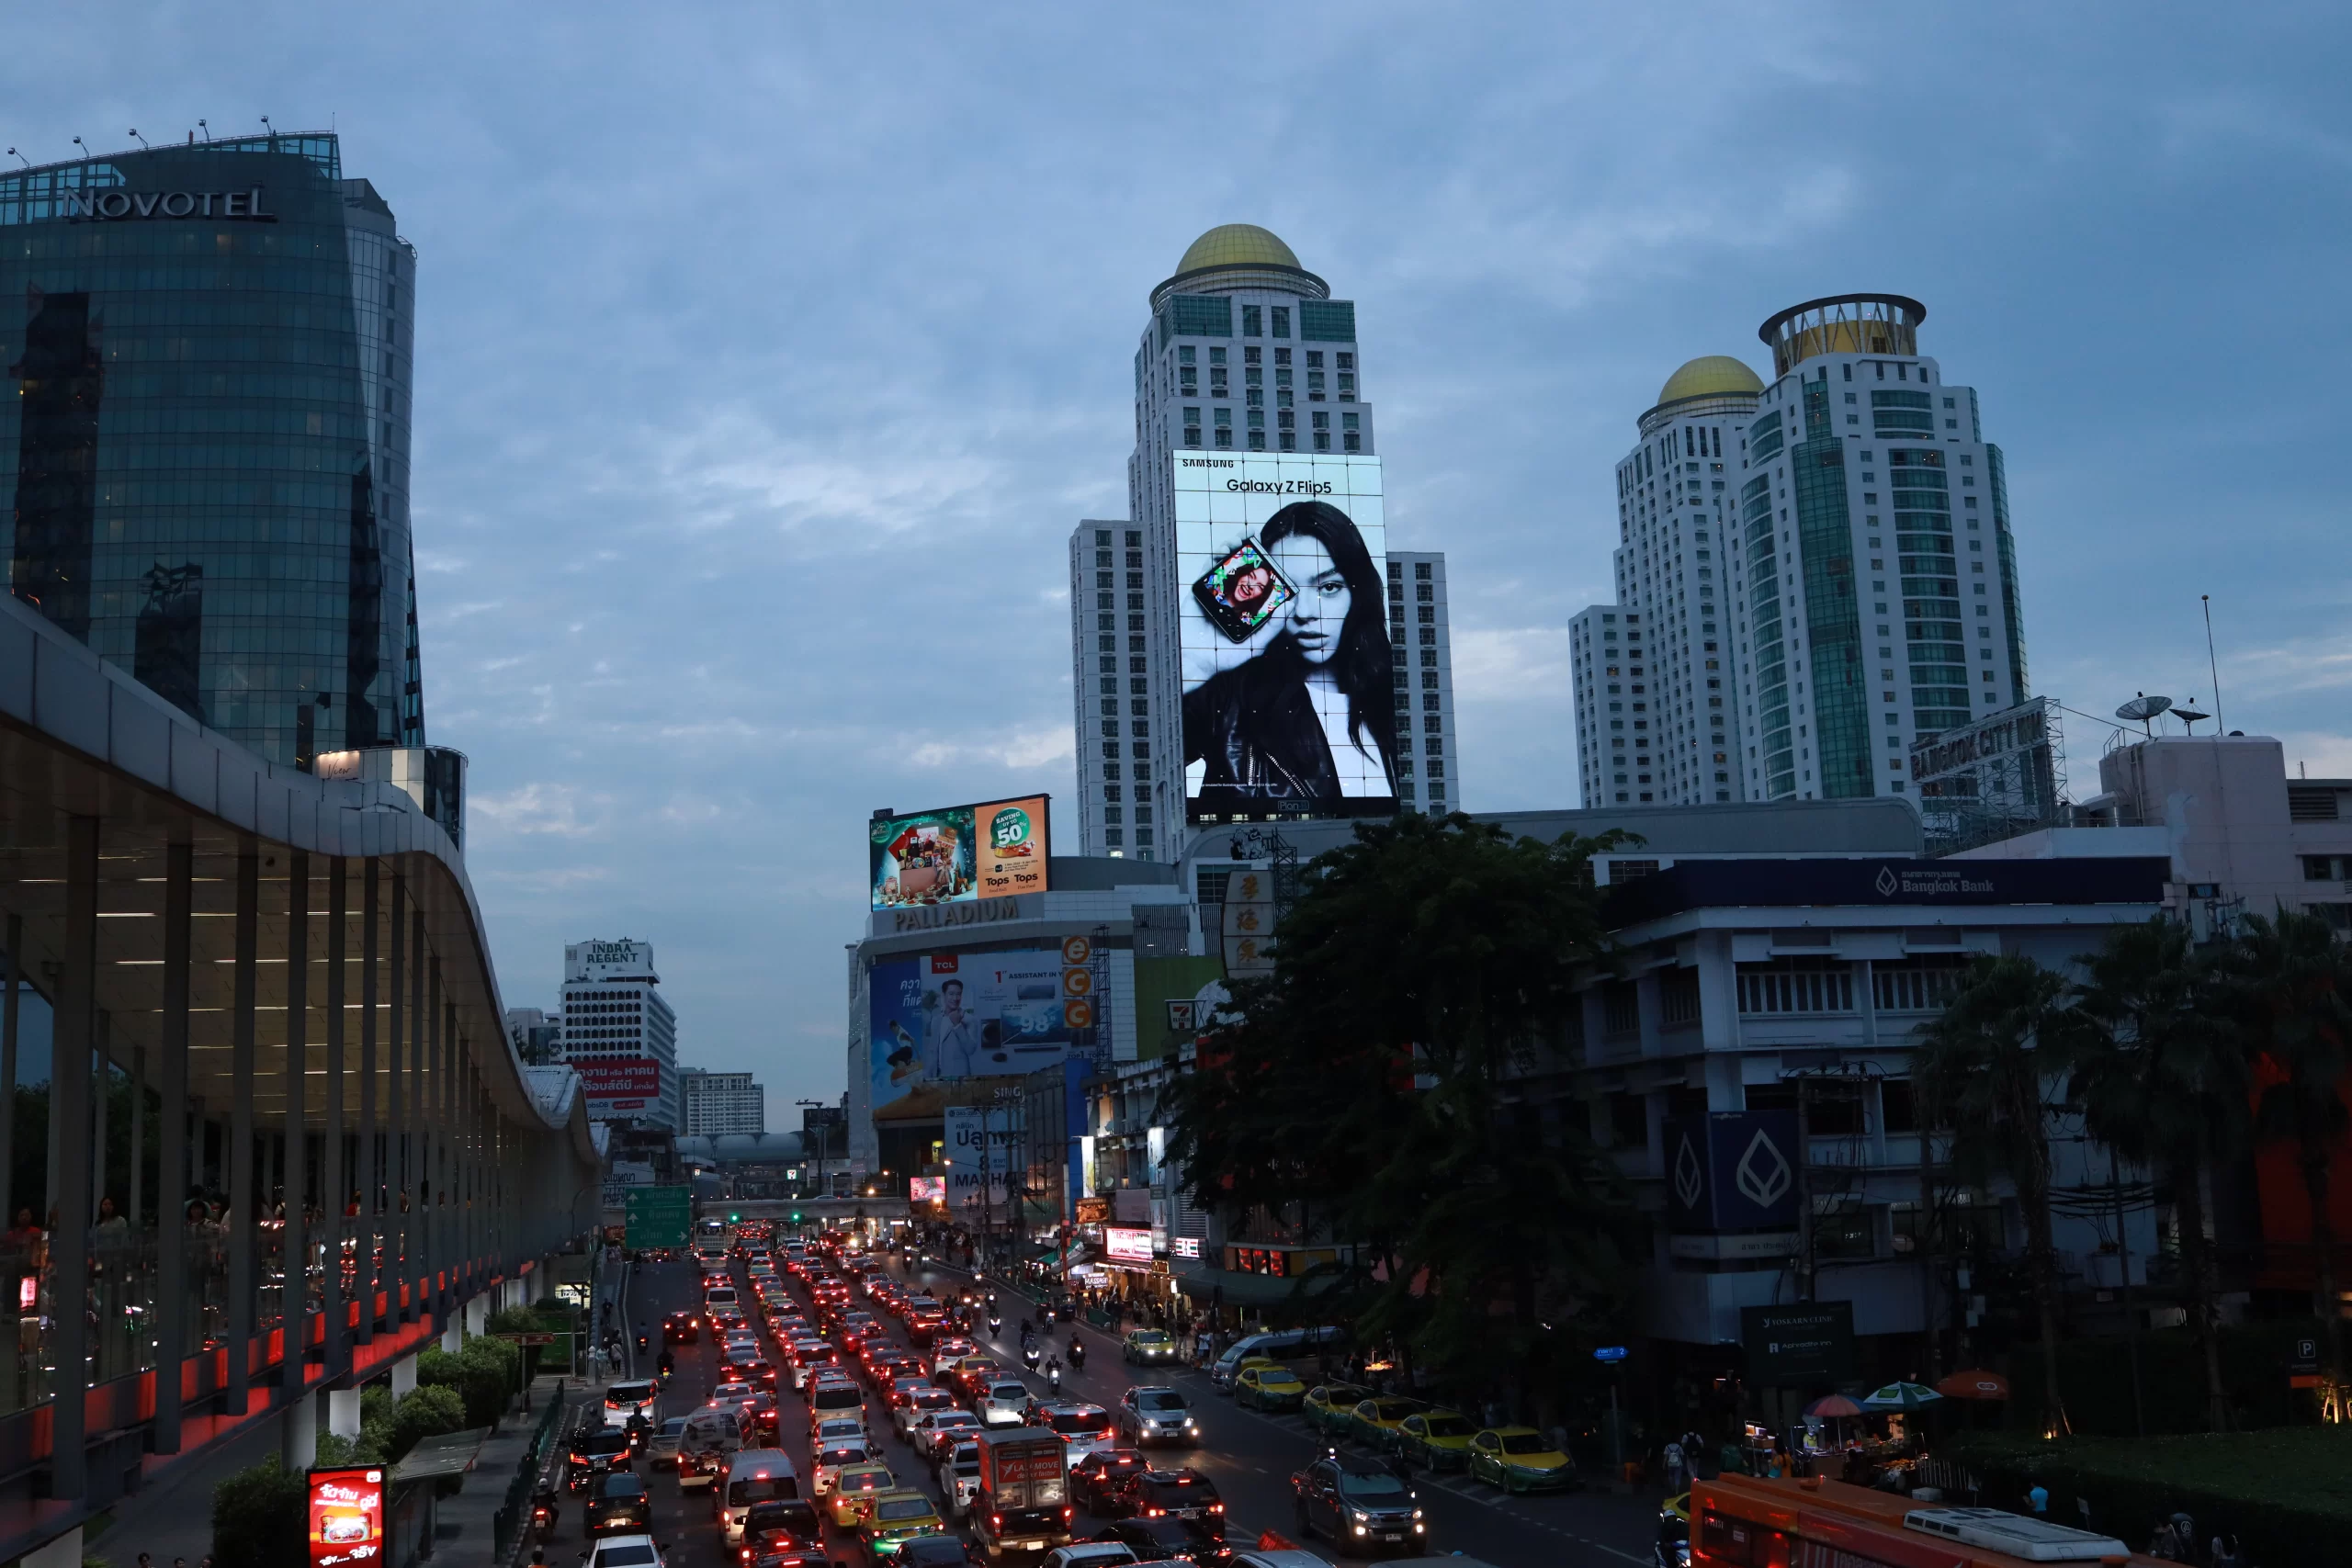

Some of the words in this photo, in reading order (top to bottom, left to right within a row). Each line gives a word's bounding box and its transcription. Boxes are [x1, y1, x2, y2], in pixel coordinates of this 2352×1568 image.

[62, 185, 275, 218] NOVOTEL
[1182, 459, 1235, 468] SAMSUNG
[1227, 479, 1283, 496] Galaxy
[1286, 480, 1295, 492] Z
[1297, 480, 1332, 497] Flip5
[1911, 734, 1976, 781] BANGKOK
[1979, 720, 2015, 755] CITY
[996, 812, 1021, 824] SAVING
[985, 877, 1010, 887] Tops
[1014, 874, 1038, 884] Tops
[1903, 880, 1959, 895] Bangkok
[1962, 879, 1995, 892] Bank
[895, 897, 1019, 932] PALLADIUM
[593, 943, 631, 953] INDRA
[587, 953, 638, 963] REGENT
[625, 1066, 655, 1076] หาคน
[1772, 1317, 1809, 1327] YOSKARN
[1810, 1315, 1836, 1325] CLINIC
[2302, 1342, 2312, 1355] P
[1013, 1461, 1059, 1472] LAAMOVE
[320, 1483, 359, 1500] จัดจ้าน
